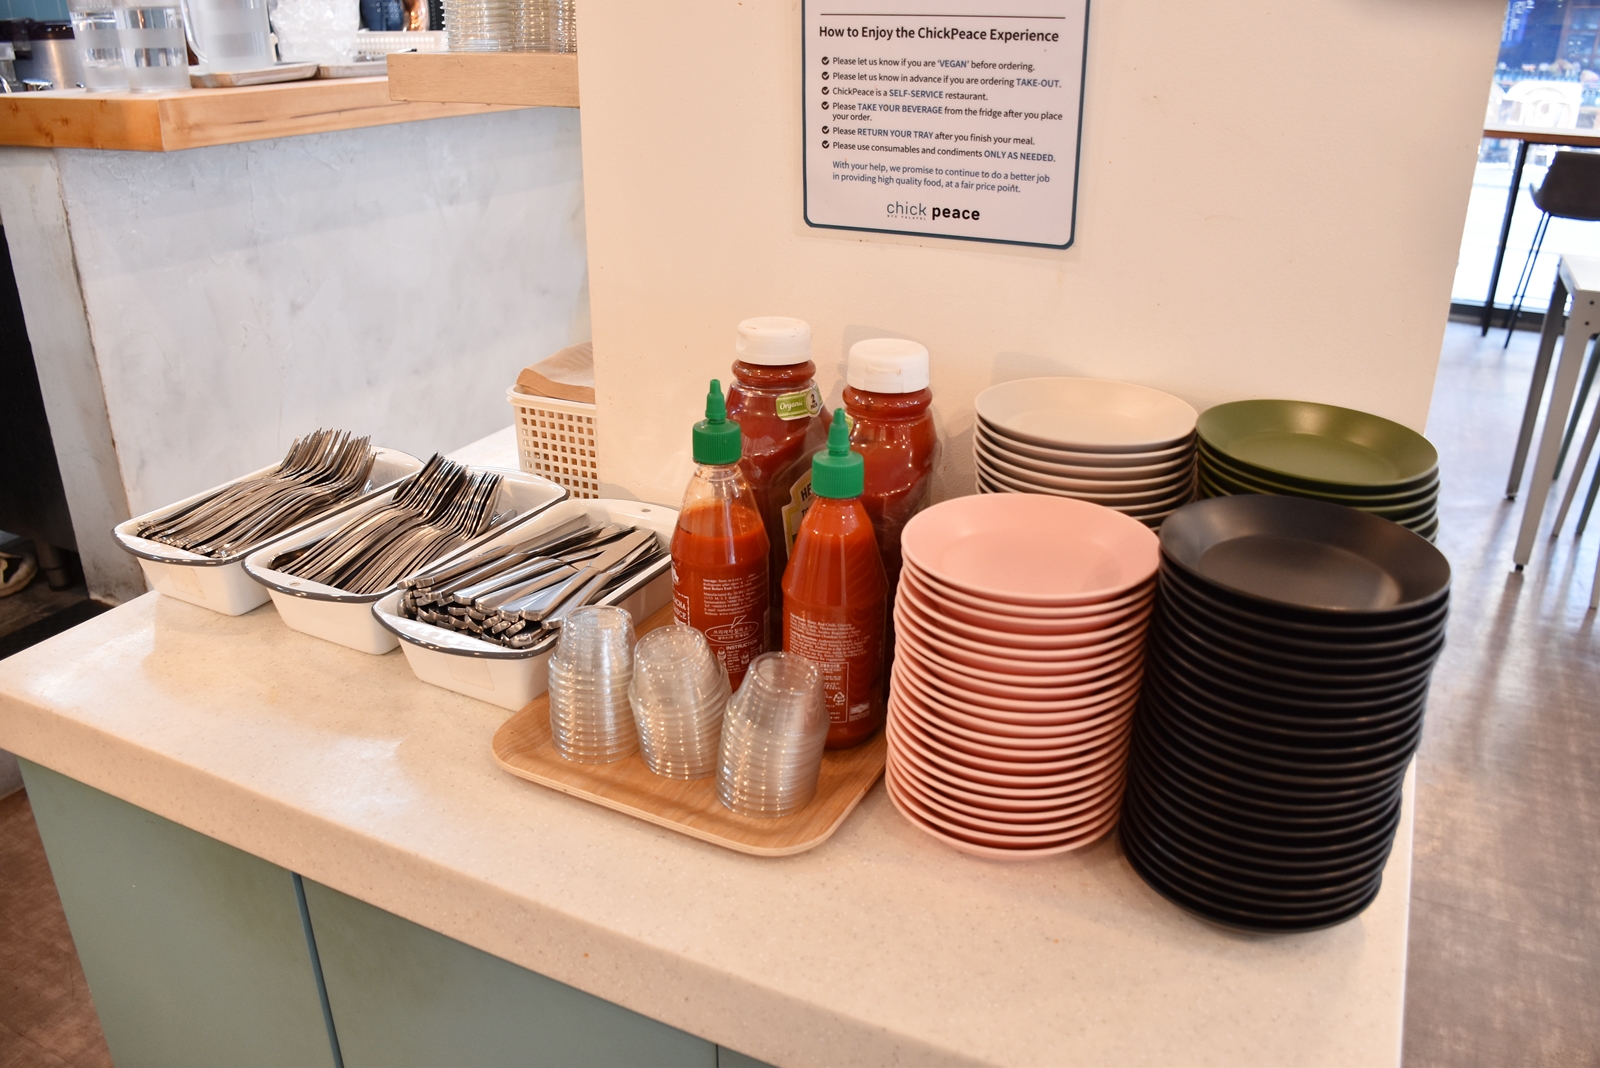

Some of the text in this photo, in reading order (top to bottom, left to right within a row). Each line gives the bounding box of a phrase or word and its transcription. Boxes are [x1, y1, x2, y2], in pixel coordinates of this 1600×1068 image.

[820, 26, 1059, 43] How to Enjoy the ChickPeace Experience
[833, 57, 856, 65] Please
[858, 57, 867, 65] let
[879, 58, 900, 66] know
[907, 60, 922, 68] you
[971, 60, 997, 69] before
[998, 62, 1035, 73] ordering.
[833, 72, 856, 80] Please
[858, 72, 867, 81] let
[879, 73, 900, 82] know
[901, 74, 908, 82] in
[909, 74, 942, 83] advance
[943, 75, 949, 83] if
[950, 78, 964, 86] you
[980, 77, 1014, 88] ordering
[1016, 78, 1061, 88] TAKE-OUT.
[832, 87, 874, 96] ChickPeace
[876, 88, 882, 96] is
[889, 89, 943, 98] SELF-SERVICE
[945, 92, 988, 100] restaurant.
[832, 102, 1063, 121] Please TAKE YOUR BEVERAGE from the fridge after you place
[833, 127, 856, 135] Please
[858, 128, 888, 136] RETURN
[890, 130, 912, 138] YOUR
[913, 131, 934, 139] TRAY
[934, 132, 953, 140] after
[970, 133, 992, 142] finish
[993, 137, 1012, 145] your
[1013, 137, 1035, 145] meal.
[833, 142, 856, 150] Please
[871, 145, 920, 154] consumables
[921, 146, 936, 154] and
[937, 148, 982, 157] condiments
[984, 150, 1006, 158] ONLY
[1020, 152, 1055, 162] NEEDED.
[832, 160, 850, 169] With
[869, 162, 888, 173] help,
[902, 166, 934, 174] promise
[944, 168, 980, 178] continue
[991, 170, 1002, 179] do
[1010, 172, 1036, 181] better
[1036, 174, 1050, 184] job
[833, 172, 840, 180] in
[841, 174, 876, 184] providing
[878, 175, 894, 185] high
[896, 177, 922, 187] quality
[924, 178, 944, 188] food,
[961, 180, 974, 189] fair
[976, 182, 996, 191] price
[997, 184, 1020, 193] point.
[886, 201, 980, 220] chick peace
[780, 399, 804, 412] Organic
[810, 394, 816, 403] 2
